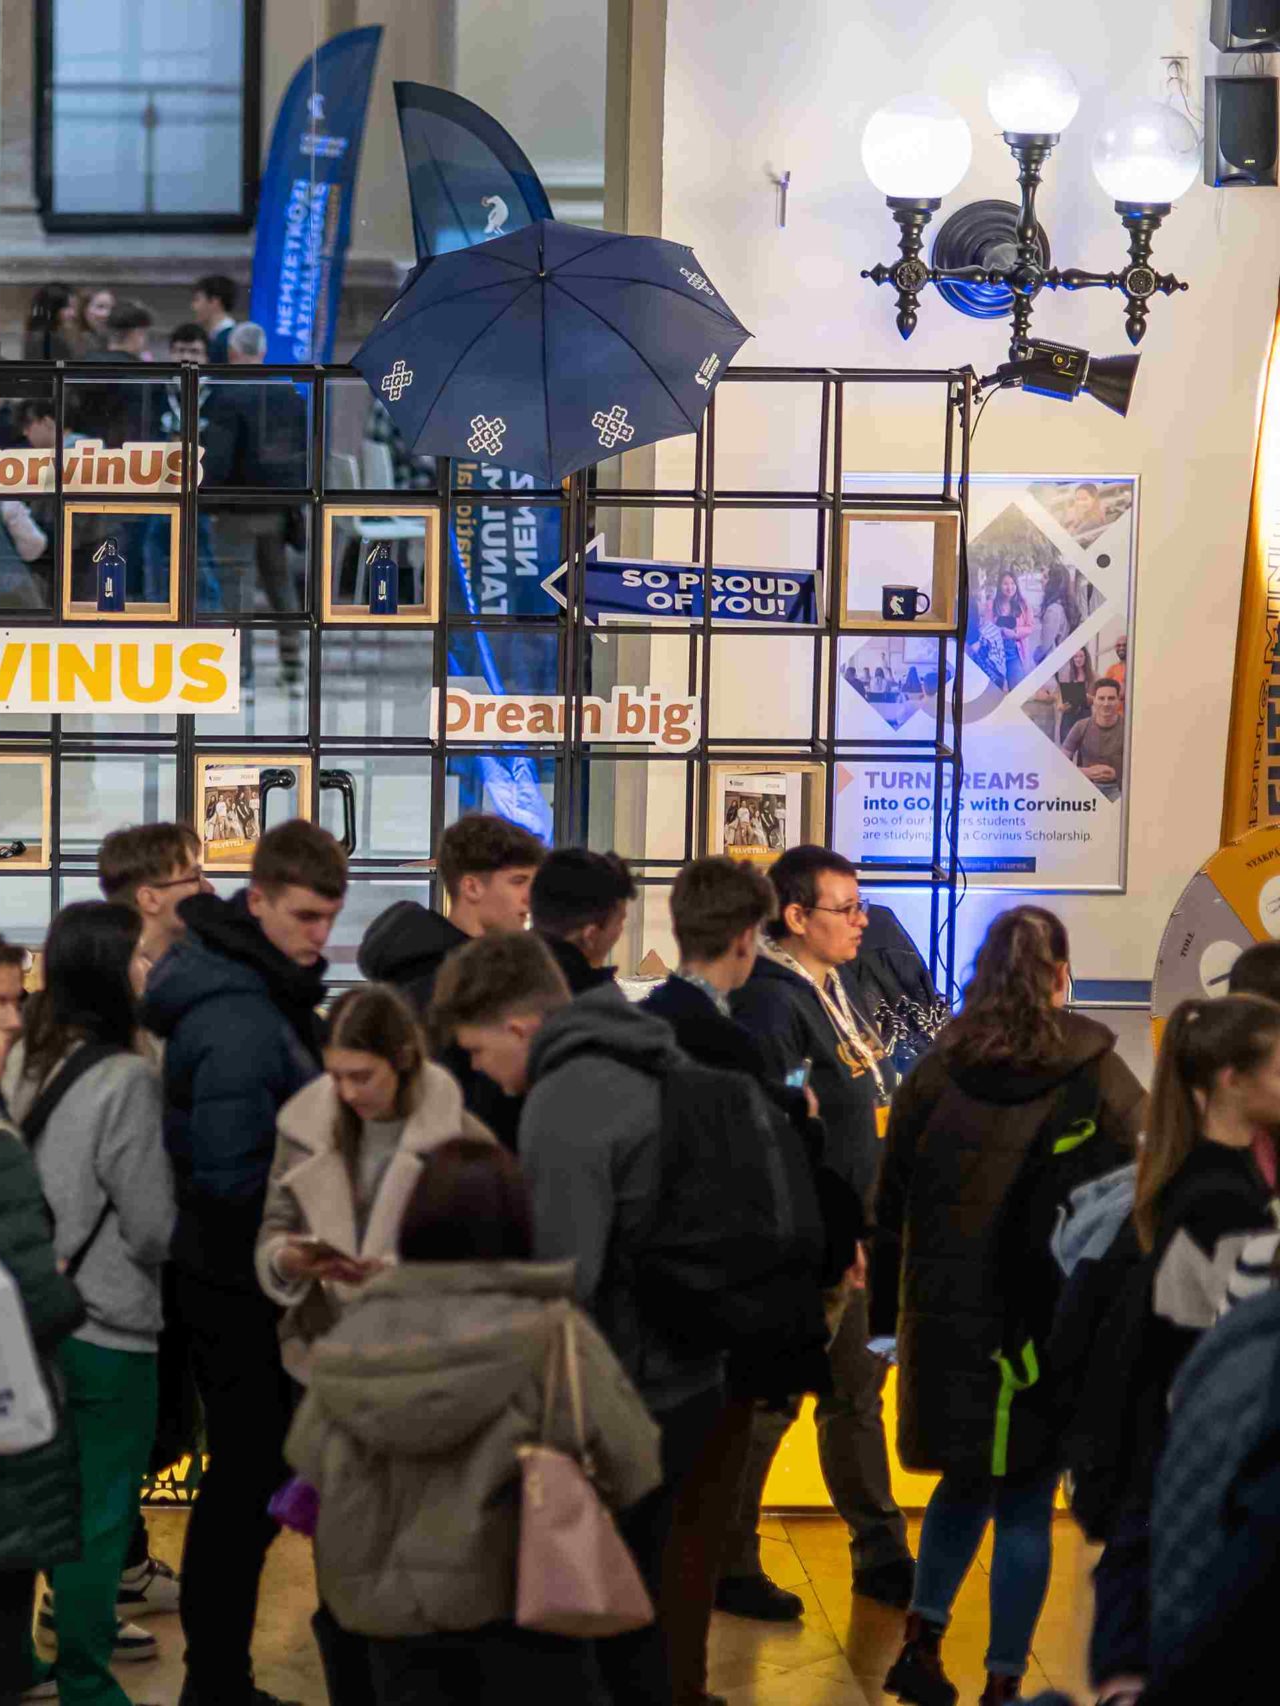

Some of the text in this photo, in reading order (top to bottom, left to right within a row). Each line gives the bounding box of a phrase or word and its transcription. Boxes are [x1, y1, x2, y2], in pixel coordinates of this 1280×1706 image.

[622, 569, 800, 596] SO PROUD
[646, 592, 786, 616] OF YOU!
[437, 693, 694, 745] Dream big
[864, 771, 1040, 790] TURN DREAMS
[863, 795, 1097, 812] into GOLS with Corvinus!
[863, 816, 888, 827] 90%
[891, 816, 903, 826] of
[906, 817, 926, 826] our
[976, 816, 1026, 827] students
[863, 831, 880, 840] are
[884, 829, 932, 843] studying
[963, 831, 970, 840] a
[973, 829, 1022, 841] Corvinus
[1025, 829, 1093, 844] Scholarship.
[1180, 931, 1195, 958] TOLL
